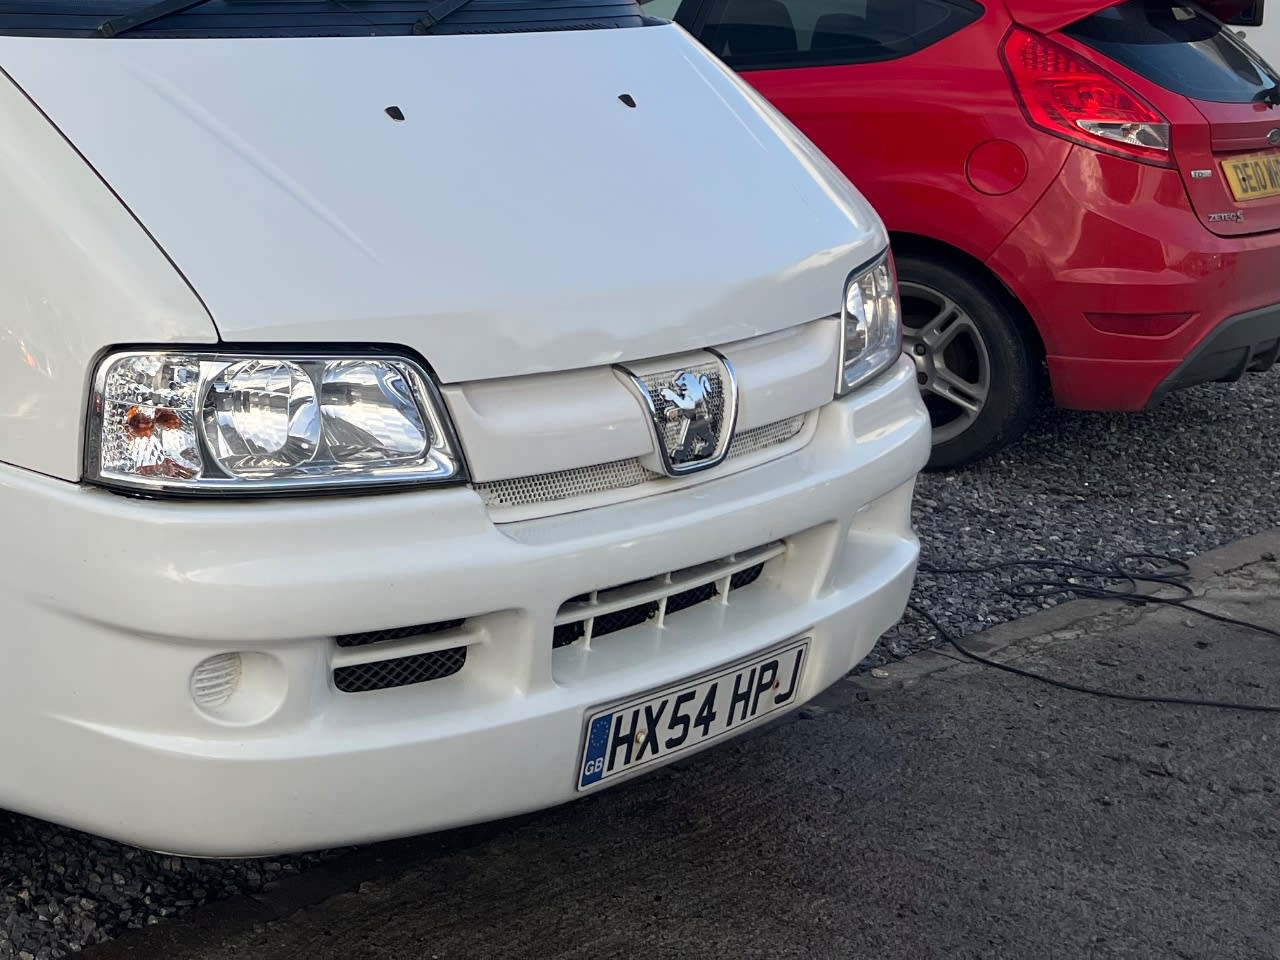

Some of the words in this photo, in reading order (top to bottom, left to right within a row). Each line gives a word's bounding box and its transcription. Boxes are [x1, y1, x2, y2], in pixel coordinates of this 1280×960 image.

[607, 682, 718, 772] HX54
[727, 649, 803, 727] HPJ
[585, 757, 603, 775] GB
